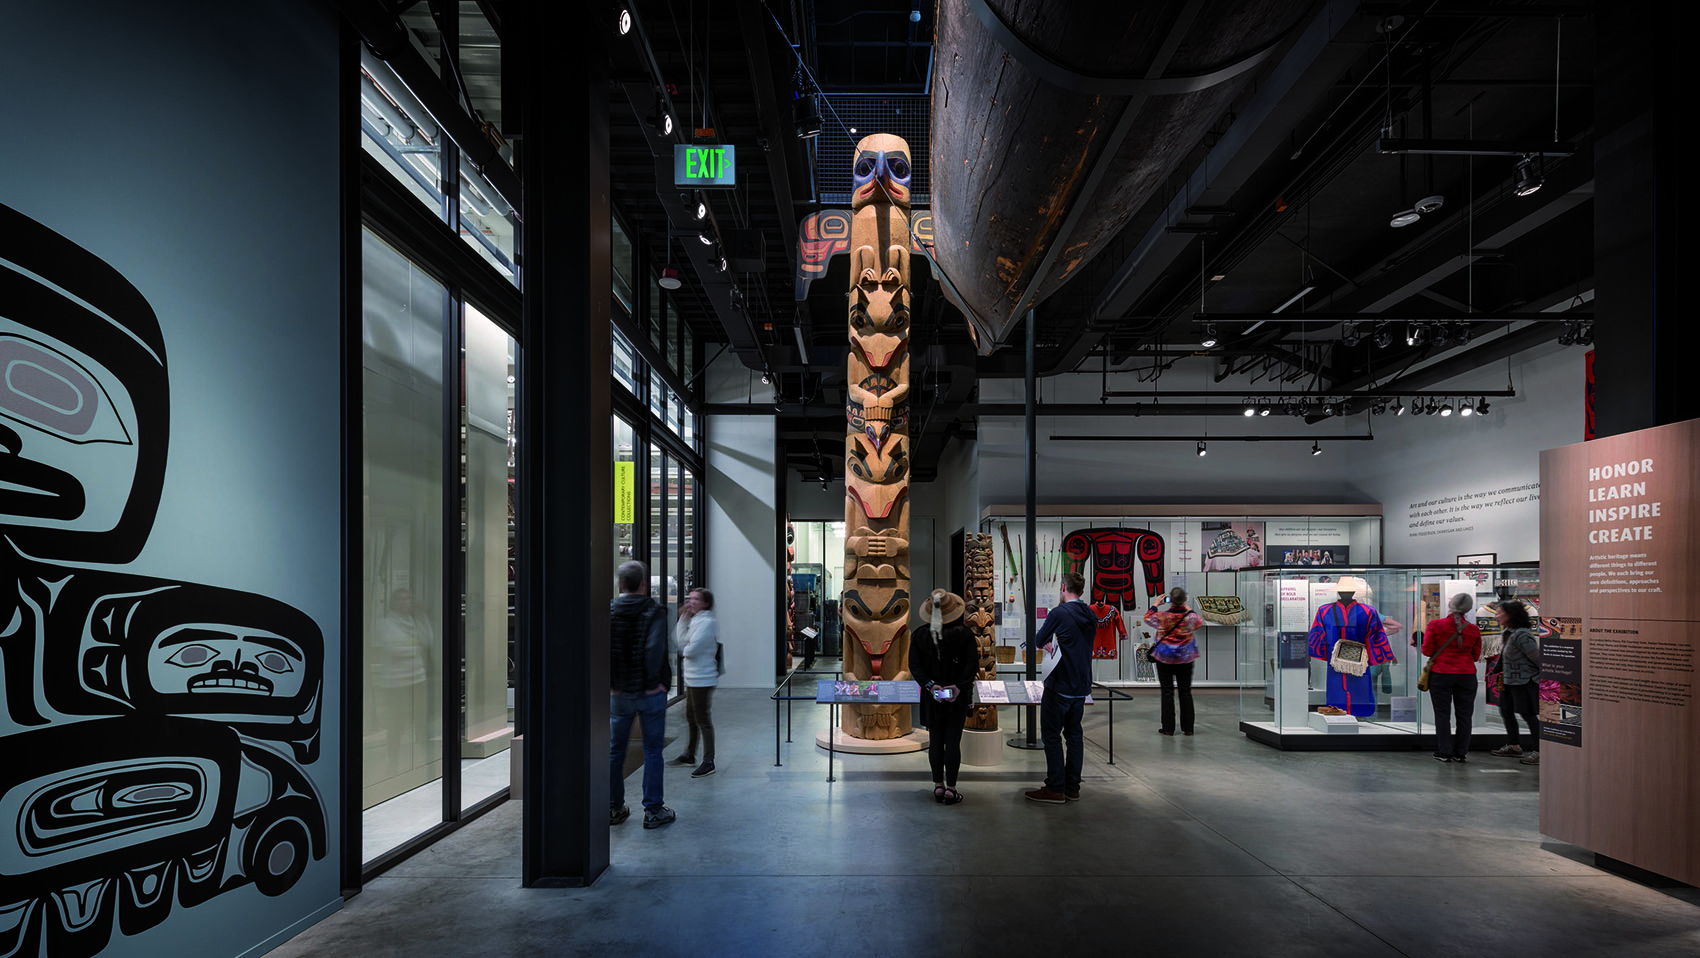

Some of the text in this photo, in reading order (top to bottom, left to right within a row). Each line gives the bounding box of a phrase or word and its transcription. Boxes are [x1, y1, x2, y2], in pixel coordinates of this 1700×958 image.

[686, 149, 726, 178] EXIT
[1589, 458, 1654, 482] HONOR
[1438, 497, 1457, 505] culture
[1589, 482, 1646, 502] LEARN
[1433, 507, 1448, 515] other.
[1494, 498, 1514, 508] reflect
[1589, 502, 1661, 523] INSPIRE
[1420, 519, 1435, 527] define
[1589, 526, 1652, 544] CREATE
